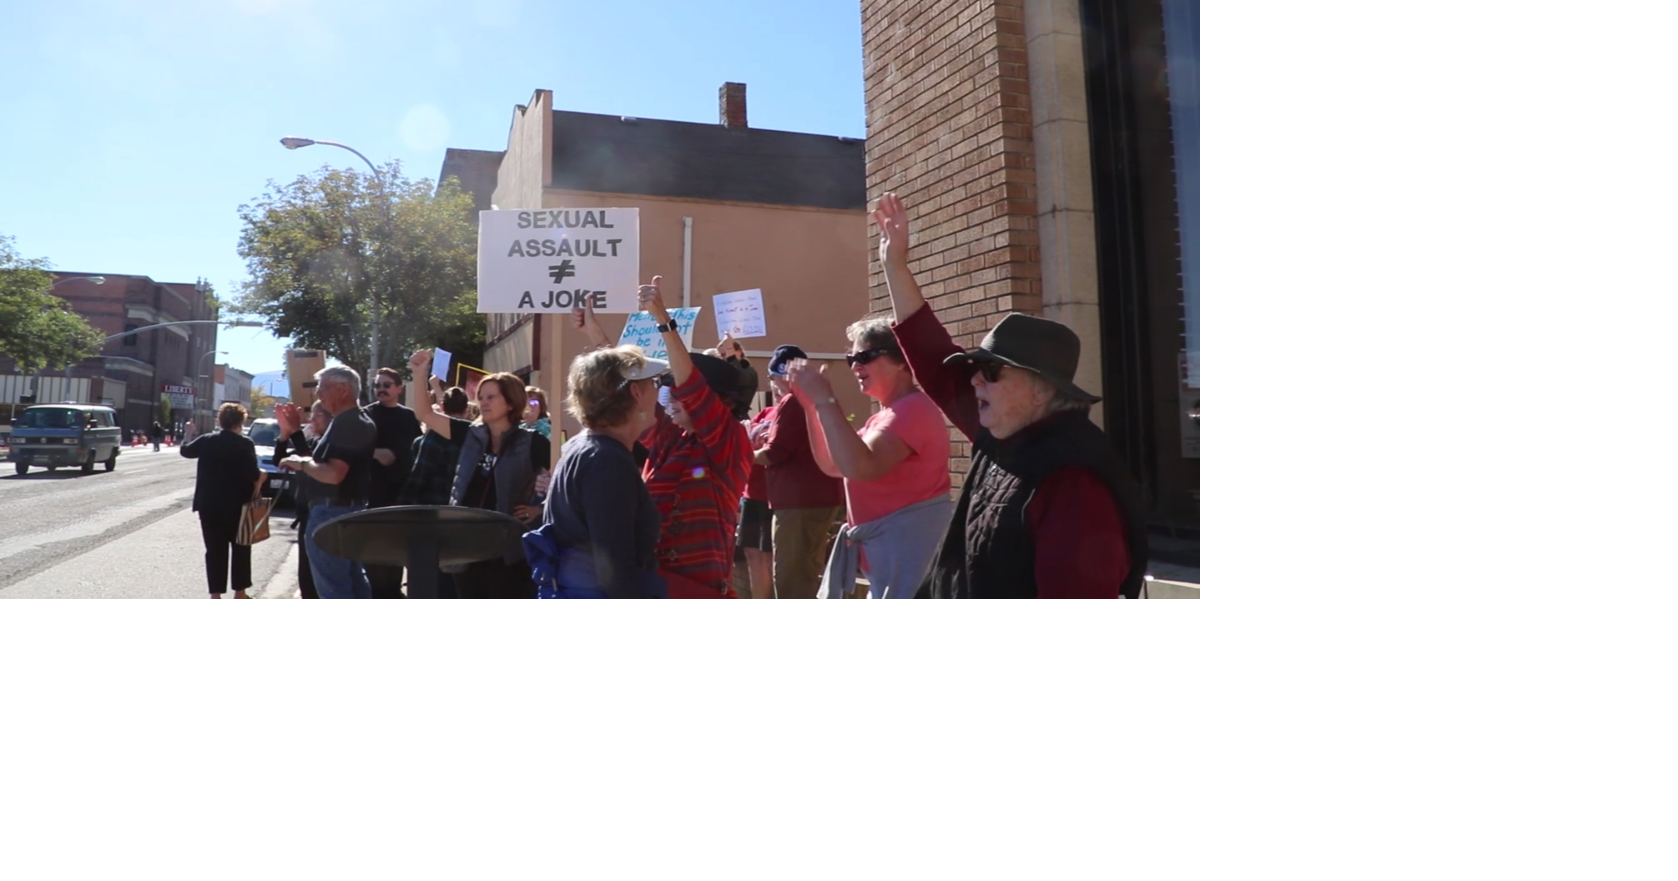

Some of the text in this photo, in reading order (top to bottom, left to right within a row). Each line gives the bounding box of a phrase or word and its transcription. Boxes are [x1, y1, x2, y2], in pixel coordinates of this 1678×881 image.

[517, 210, 614, 229] SEXUAL
[507, 239, 622, 257] ASSAULT
[517, 289, 607, 309] A JOKE
[623, 324, 660, 338] Shoul
[636, 336, 651, 347] be
[164, 384, 193, 394] LIBERTY
